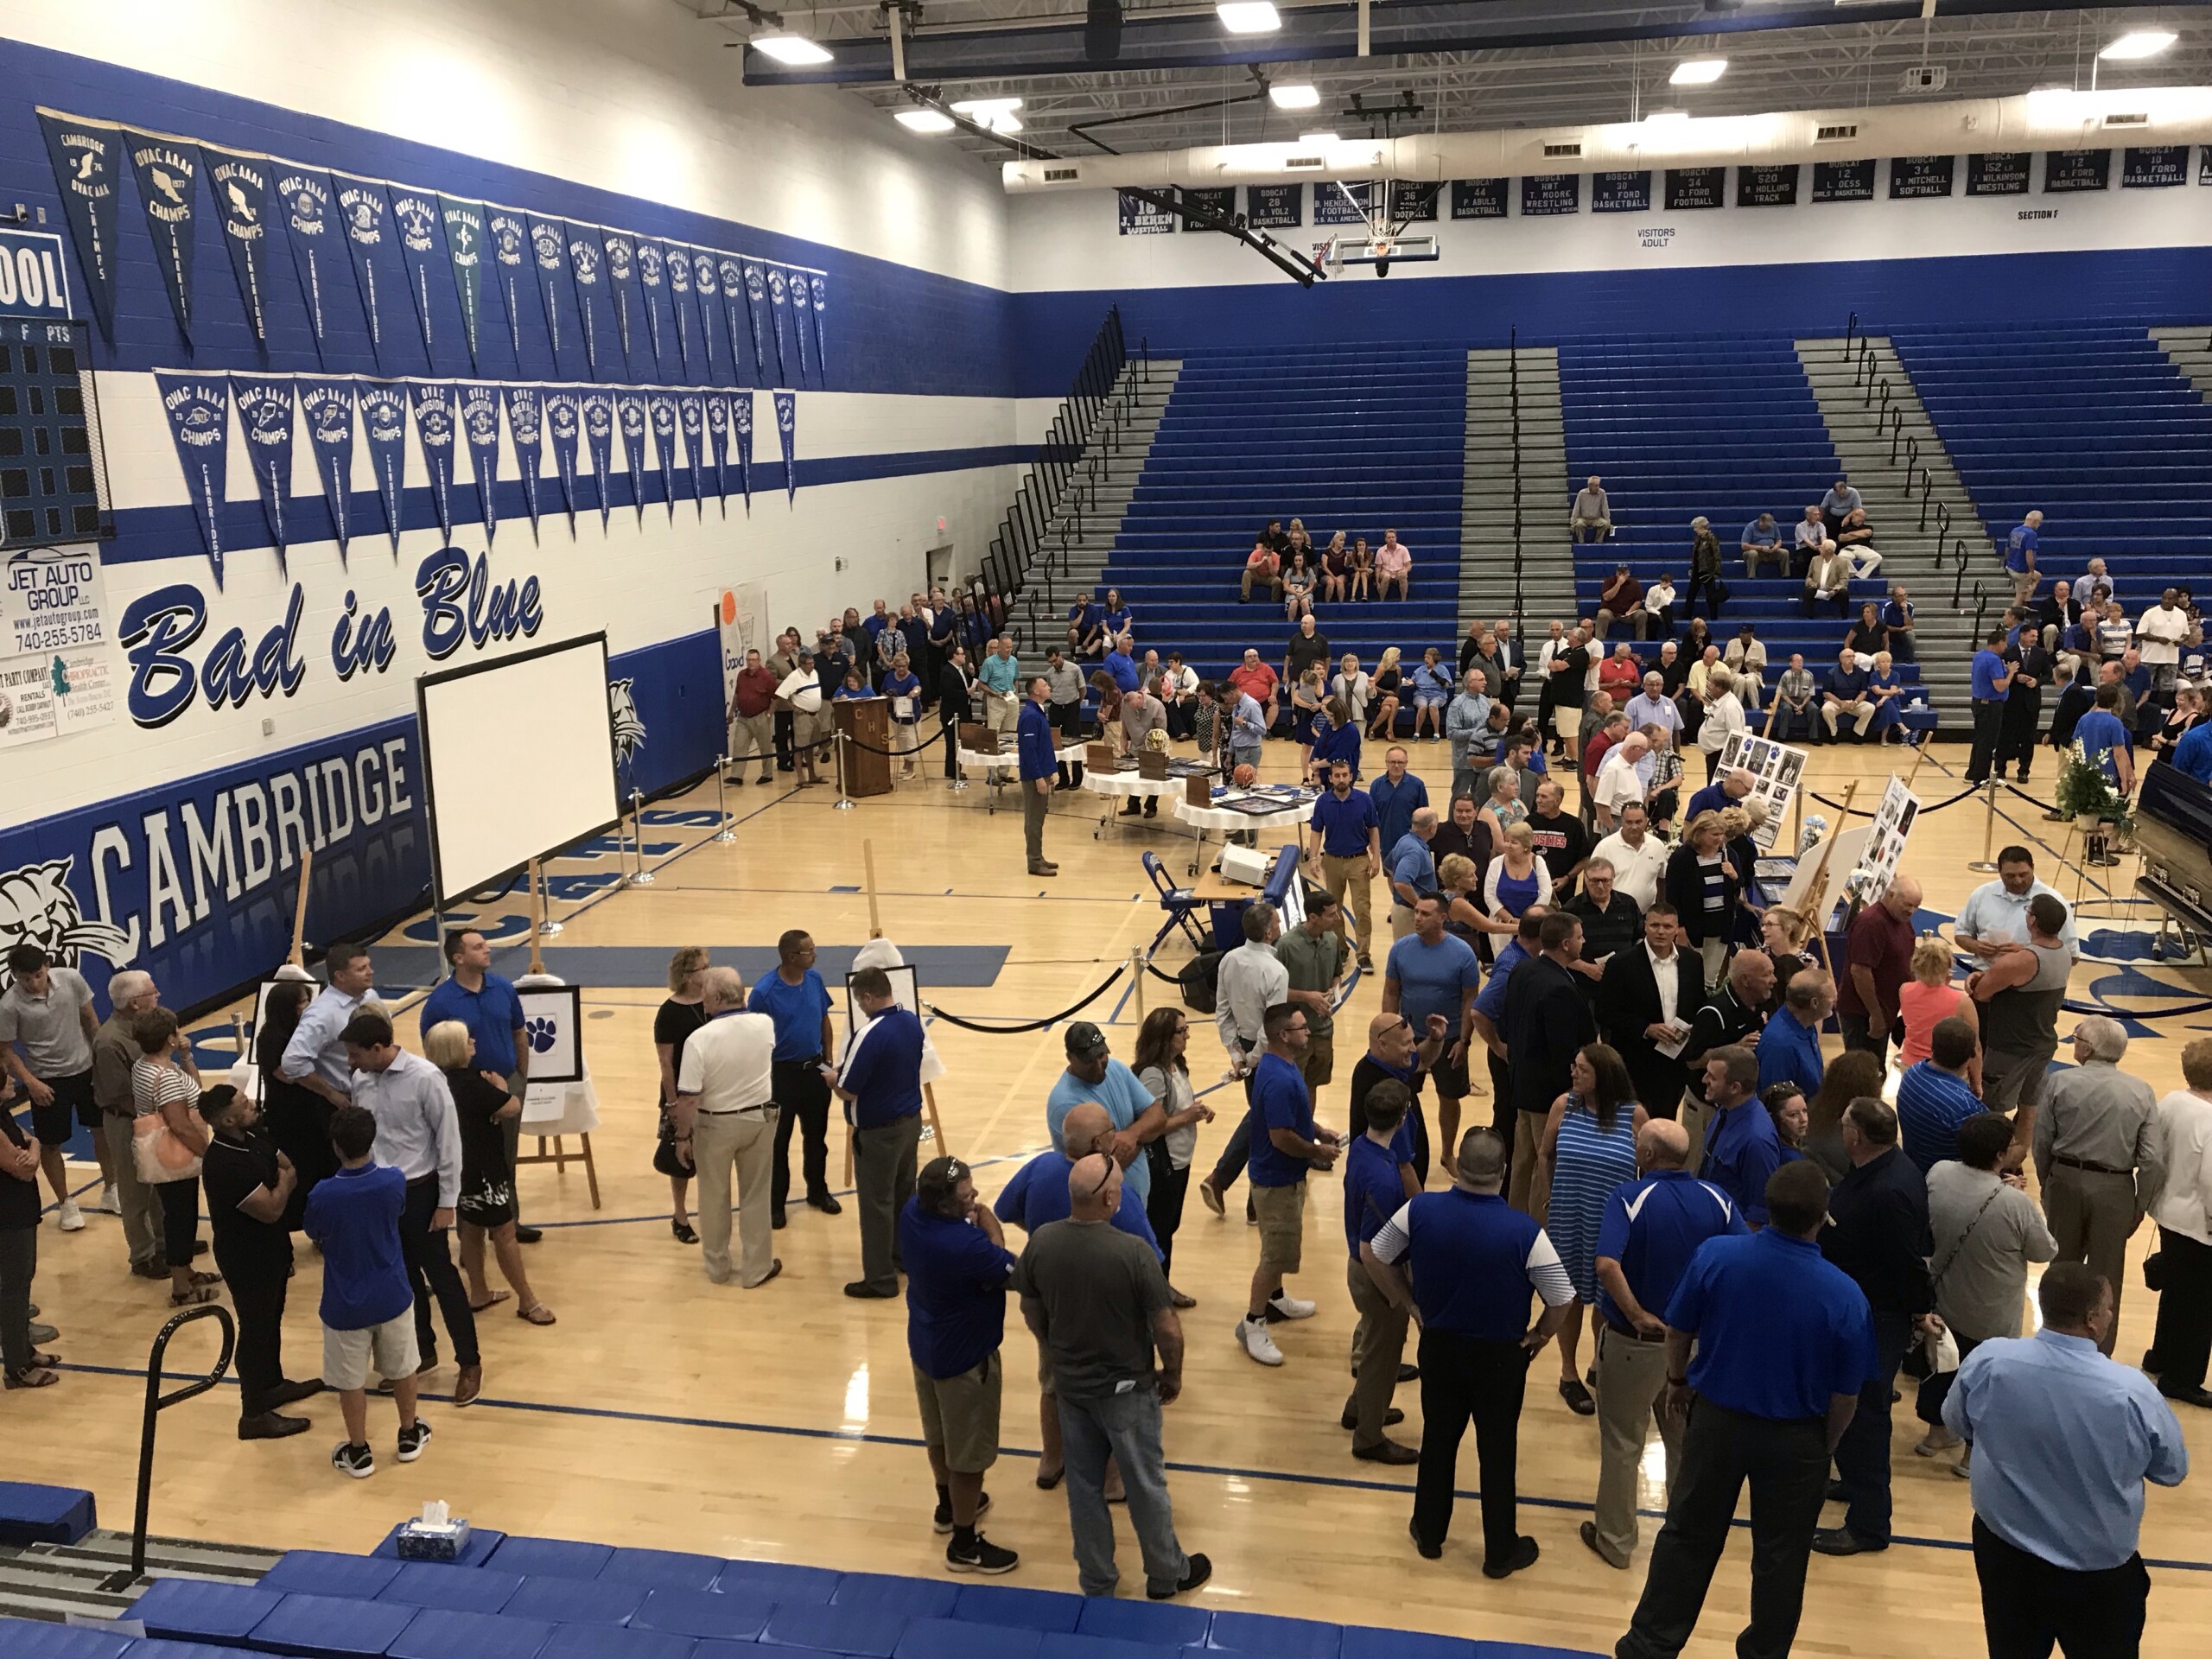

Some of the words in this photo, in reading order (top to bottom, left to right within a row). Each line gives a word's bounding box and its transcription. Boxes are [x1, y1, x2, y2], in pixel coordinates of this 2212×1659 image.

[60, 135, 105, 156] CAMBRIDGE
[135, 148, 162, 167] OVAC
[166, 150, 193, 178] AAAA
[1915, 166, 1929, 175] 34
[2072, 158, 2084, 167] 12
[2152, 164, 2176, 173] FORD
[214, 163, 237, 181] OVAC
[239, 165, 263, 190] AAAA
[1758, 175, 1777, 183] 520
[1838, 169, 1851, 178] 12
[1908, 175, 1946, 184] MITCHELL
[1983, 173, 2025, 181] WILKINSON
[2124, 174, 2184, 182] BASKETBALL
[72, 179, 93, 197] OVAC
[95, 183, 110, 197] AAA
[280, 176, 302, 195] OVAC
[305, 179, 327, 205] AAAA
[1757, 184, 1789, 193] HOLLINS
[1900, 185, 1942, 194] SOFTBALL
[2051, 178, 2101, 188] BASKETBALL
[340, 189, 359, 207] OVAC
[363, 191, 382, 214] AAAA
[1261, 188, 1287, 197] BOBCAT
[149, 200, 190, 222] CHAMPS
[396, 199, 414, 216] OVAC
[416, 200, 434, 223] AAAA
[1593, 199, 1648, 207] BASKETBALL
[445, 210, 461, 223] OVAC
[463, 212, 479, 230] AAAA
[1254, 216, 1295, 225] BASKETBALL
[2018, 210, 2052, 219] SECTION
[228, 220, 263, 239] CHAMPS
[292, 215, 323, 235] CHAMPS
[491, 217, 505, 232] OVAC
[507, 219, 522, 238] AAAA
[1638, 228, 1675, 237] VISITORS
[88, 201, 105, 280] CHAMPS
[351, 226, 380, 244] CHAMPS
[405, 234, 431, 251] CHAMPS
[531, 224, 546, 239] OVAC
[548, 226, 562, 245] AAAA
[1642, 238, 1669, 247] ADULT
[455, 251, 477, 266] CHAMPS
[499, 250, 520, 265] CHAMPS
[22, 324, 29, 340] F
[47, 325, 70, 342] PTS
[166, 386, 190, 410] OVAC
[197, 386, 226, 410] AAAA
[238, 387, 261, 410] OVAC
[265, 387, 290, 410] AAAA
[303, 388, 325, 410] OVAC
[328, 388, 351, 410] AAAA
[361, 391, 381, 410] OVAC
[384, 391, 404, 411] AAAA
[422, 386, 444, 399] OVAC
[468, 387, 490, 400] OVAC
[513, 389, 533, 401] OVAC
[415, 399, 444, 420] DIVISION
[463, 400, 493, 419] DIVISION
[511, 401, 538, 417] OVERALL
[547, 395, 561, 412] OVAC
[181, 428, 220, 446] CHAMPS
[251, 428, 287, 445] CHAMPS
[316, 427, 347, 442] CHAMPS
[372, 426, 401, 442] CHAMPS
[425, 431, 451, 446] CHAMPS
[472, 431, 495, 445] CHAMPS
[517, 430, 538, 444] CHAMPS
[202, 463, 220, 562] CAMBRIDGE
[8, 568, 38, 591] JET
[46, 562, 92, 587] AUTO
[28, 586, 78, 611] GROUP
[79, 595, 90, 605] LLC
[13, 608, 99, 630] www.jetautogroup.com
[16, 623, 101, 652] 740-255-5784
[118, 582, 305, 729] Bad
[333, 588, 396, 683] in
[415, 546, 543, 662] Blue
[726, 649, 744, 671] Good
[4, 671, 22, 687] PARTY
[23, 667, 48, 683] COMPANY
[21, 691, 45, 702] RENTALS
[855, 709, 863, 719] C
[868, 721, 874, 732] H
[881, 734, 888, 744] S
[91, 736, 412, 969] CAMBRIDGE
